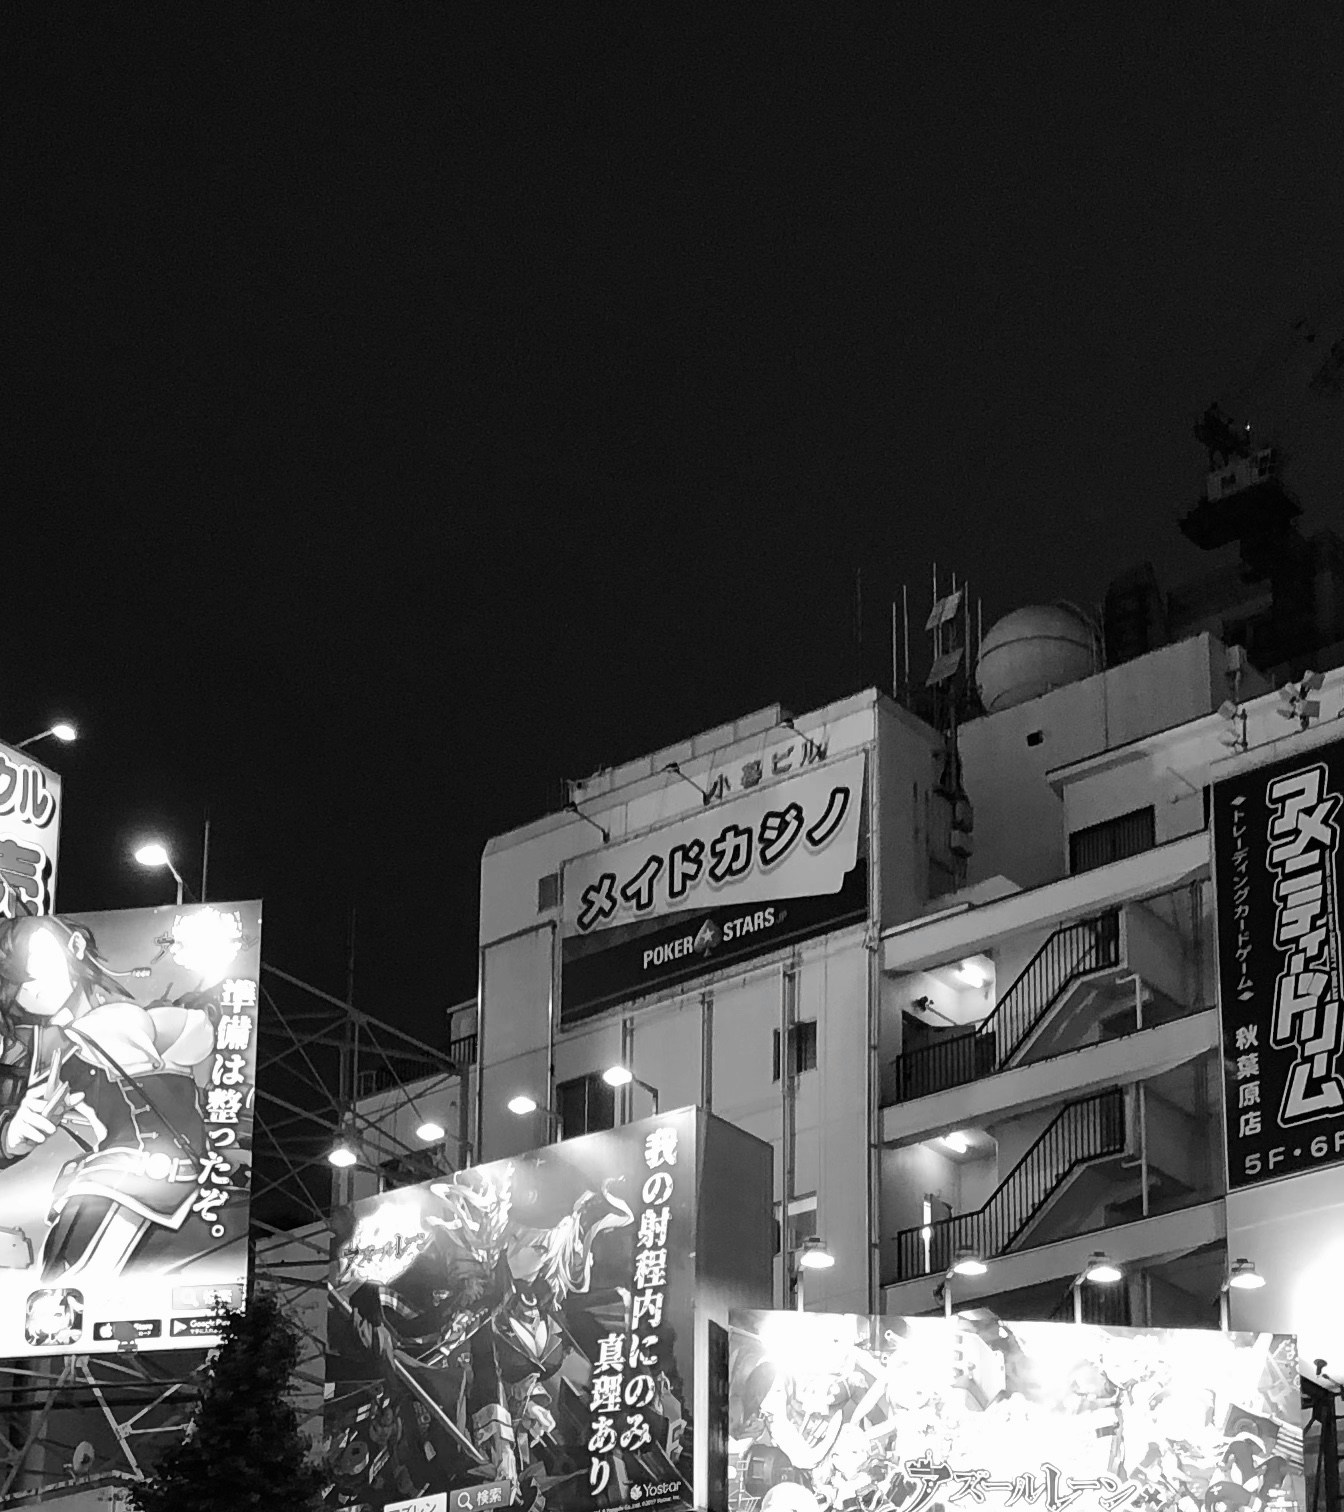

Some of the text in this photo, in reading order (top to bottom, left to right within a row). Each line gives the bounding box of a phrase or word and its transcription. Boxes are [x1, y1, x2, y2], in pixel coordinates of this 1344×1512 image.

[576, 786, 851, 932] メイドカジノ
[643, 907, 775, 970] POKER STARS
[190, 978, 257, 1239] 準備は整ったぞ。
[1234, 1024, 1262, 1138] 秋葉原店
[622, 1126, 680, 1453] 我の射程内にのみ
[587, 1333, 624, 1496] 真理あり
[476, 1487, 503, 1505] 検索
[642, 1480, 682, 1497] Yostar
